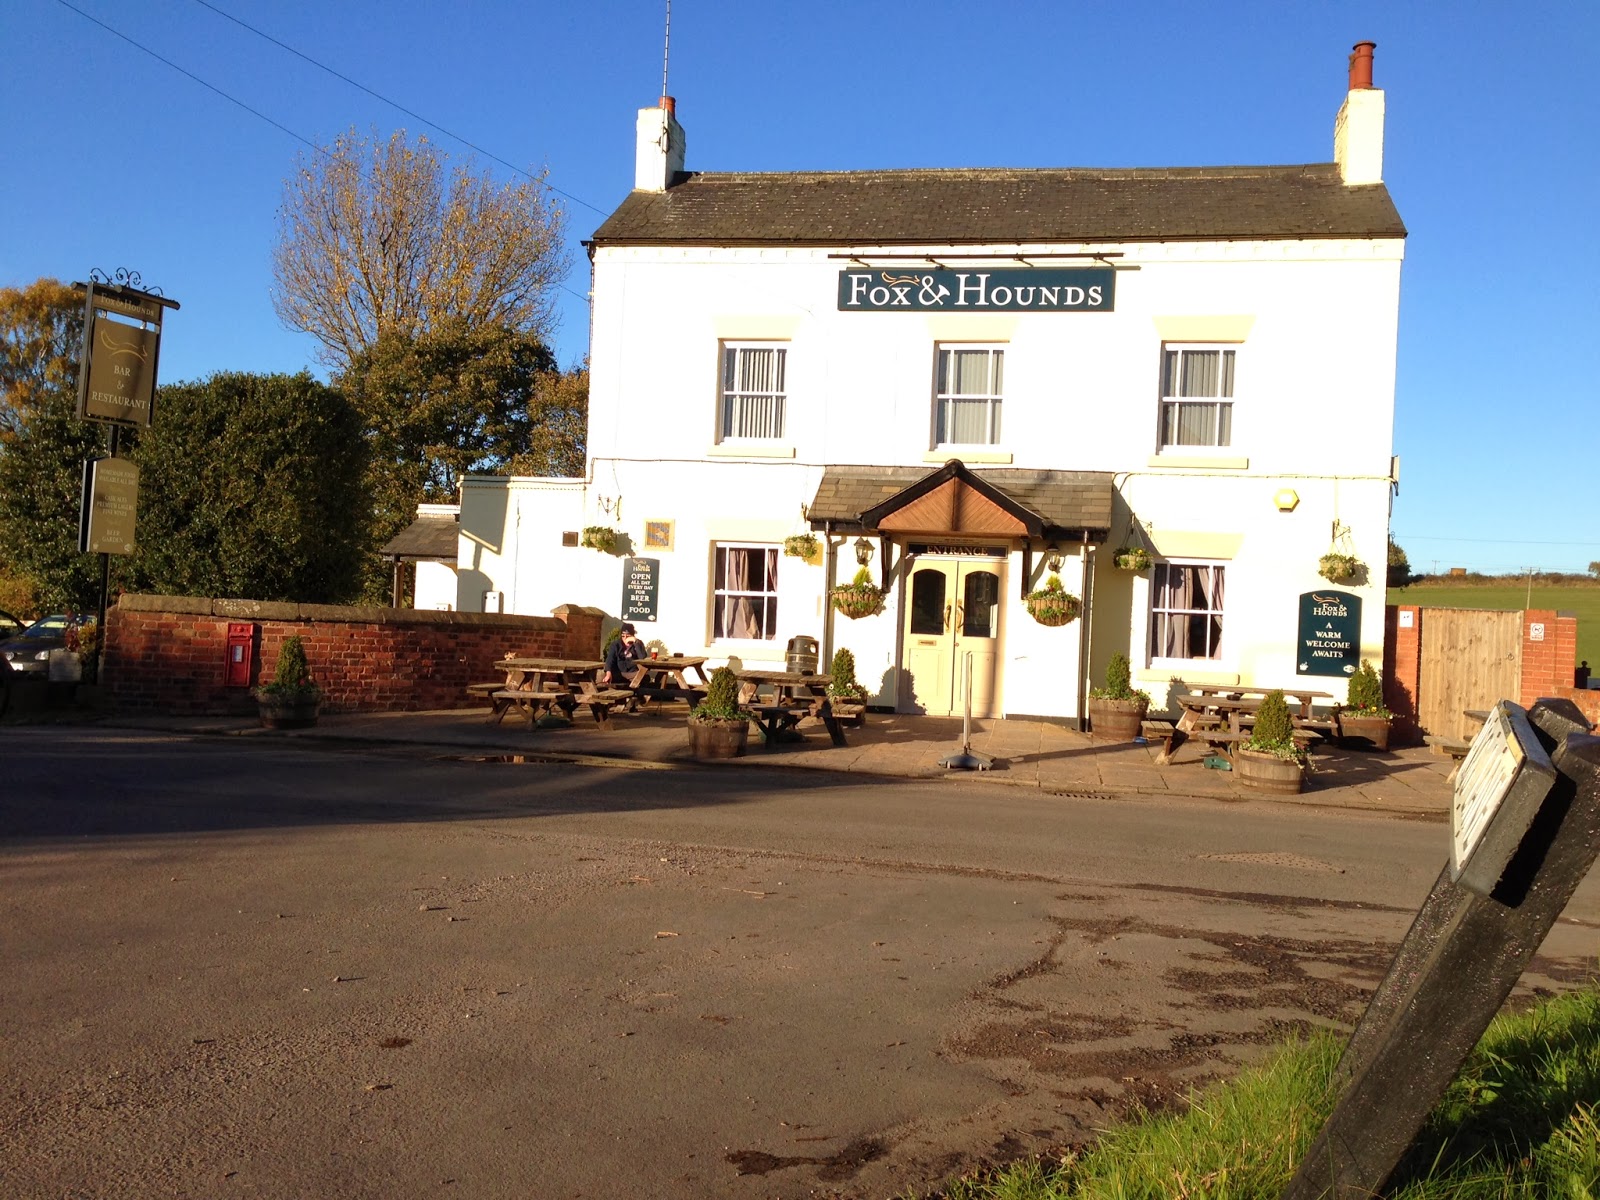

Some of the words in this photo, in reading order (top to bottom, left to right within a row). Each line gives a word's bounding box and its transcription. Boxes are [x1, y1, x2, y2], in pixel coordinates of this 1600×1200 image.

[847, 274, 911, 305] FOX
[918, 275, 951, 305] &
[954, 273, 1103, 306] HOUNDS
[124, 298, 154, 317] HOUNDS
[114, 365, 131, 377] BAR
[117, 380, 125, 390] &
[91, 391, 147, 410] RESTAURANT
[927, 545, 988, 556] ENTRANCE
[1313, 607, 1348, 617] HOUNDS
[1322, 603, 1338, 612] FOX
[1306, 640, 1350, 648] WELCOME
[1312, 650, 1343, 658] AWAITS
